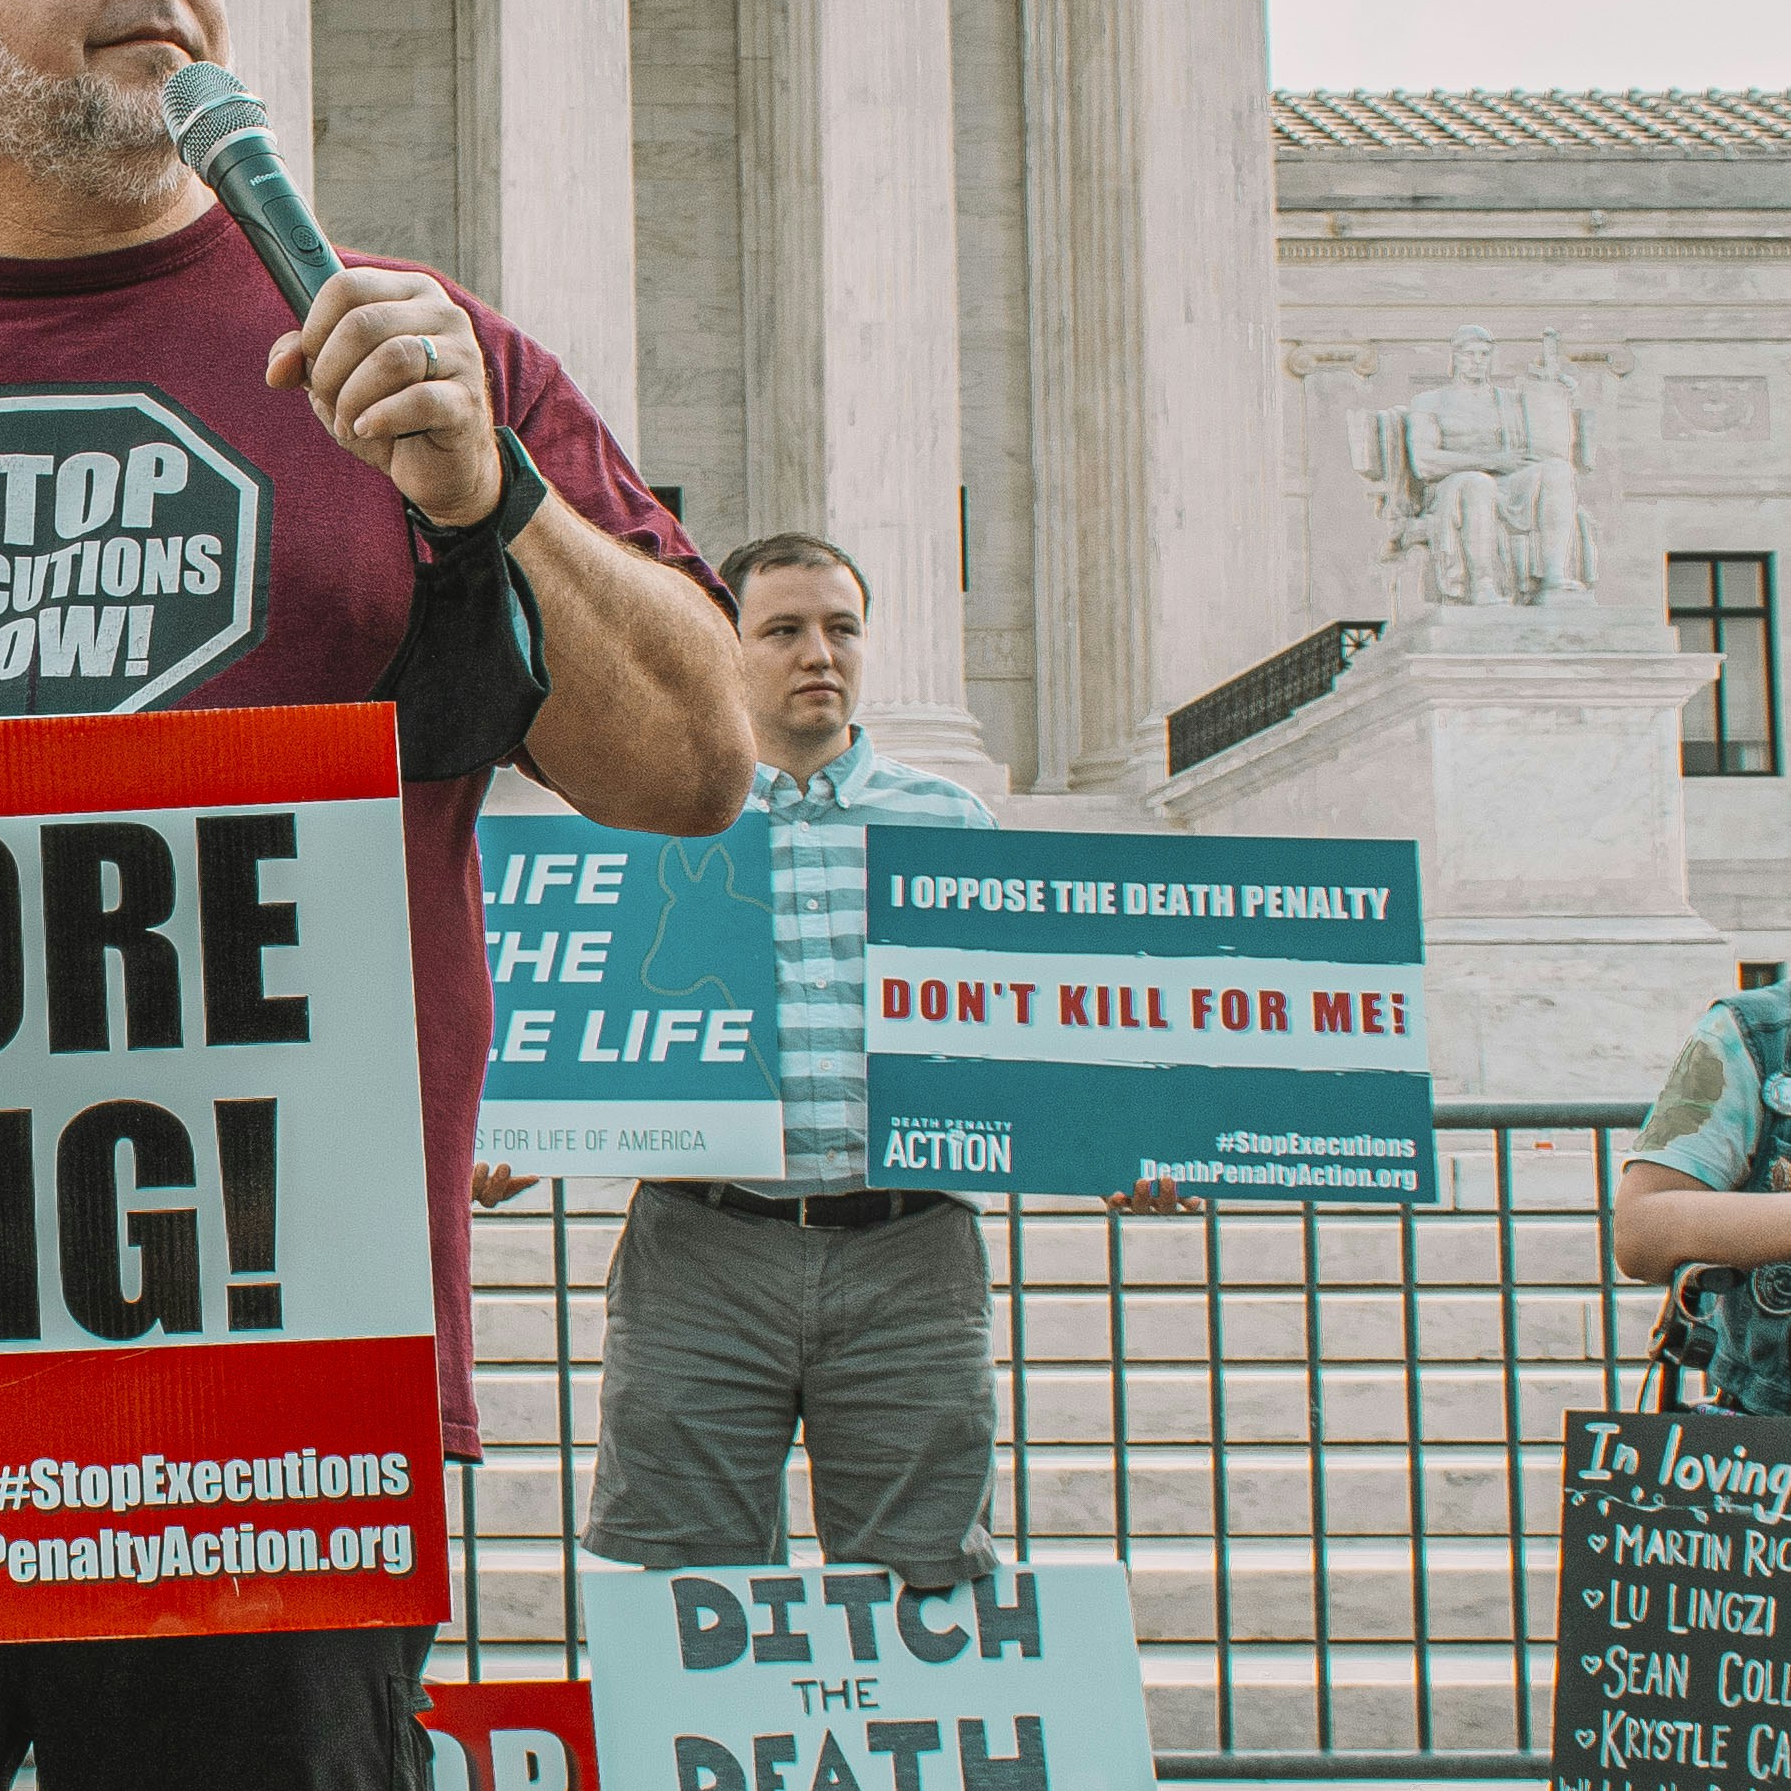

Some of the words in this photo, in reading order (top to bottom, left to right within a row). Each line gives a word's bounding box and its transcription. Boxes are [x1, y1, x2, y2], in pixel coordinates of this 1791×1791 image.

[891, 875, 904, 907] I
[912, 875, 1046, 912] OPPOSE
[1050, 880, 1116, 915] THE
[1123, 882, 1235, 917] DEATH
[1241, 885, 1389, 920] PENALTY
[882, 977, 1036, 1024] DON'T
[1058, 984, 1168, 1029] KILL
[1191, 987, 1289, 1032] FOR
[1312, 991, 1406, 1034] ME!
[578, 1010, 753, 1062] LIFE
[493, 1129, 529, 1150] FOR
[538, 1129, 576, 1150] LIFE
[585, 1129, 608, 1150] OF
[618, 1129, 706, 1151] AMERICA
[891, 1117, 940, 1129] DEATH
[945, 1119, 1012, 1132] PENALTY
[1216, 1131, 1416, 1158] #StopExecutions
[883, 1129, 1011, 1173] ACTION
[1140, 1158, 1418, 1191] DeathPenaltyAction.org
[1579, 1422, 1640, 1480] In
[1659, 1423, 1791, 1524] loving
[1614, 1523, 1731, 1572] MARTIN
[1744, 1529, 1791, 1577] RIC
[670, 1570, 1042, 1670] DITCH
[1611, 1579, 1650, 1629] LU
[1668, 1583, 1776, 1637] LINGZI
[791, 1677, 880, 1715] THE
[1603, 1645, 1689, 1699] SEAN
[1718, 1651, 1791, 1707] COLL
[1600, 1709, 1732, 1770] KRYSTLE
[1748, 1723, 1791, 1781] CA
